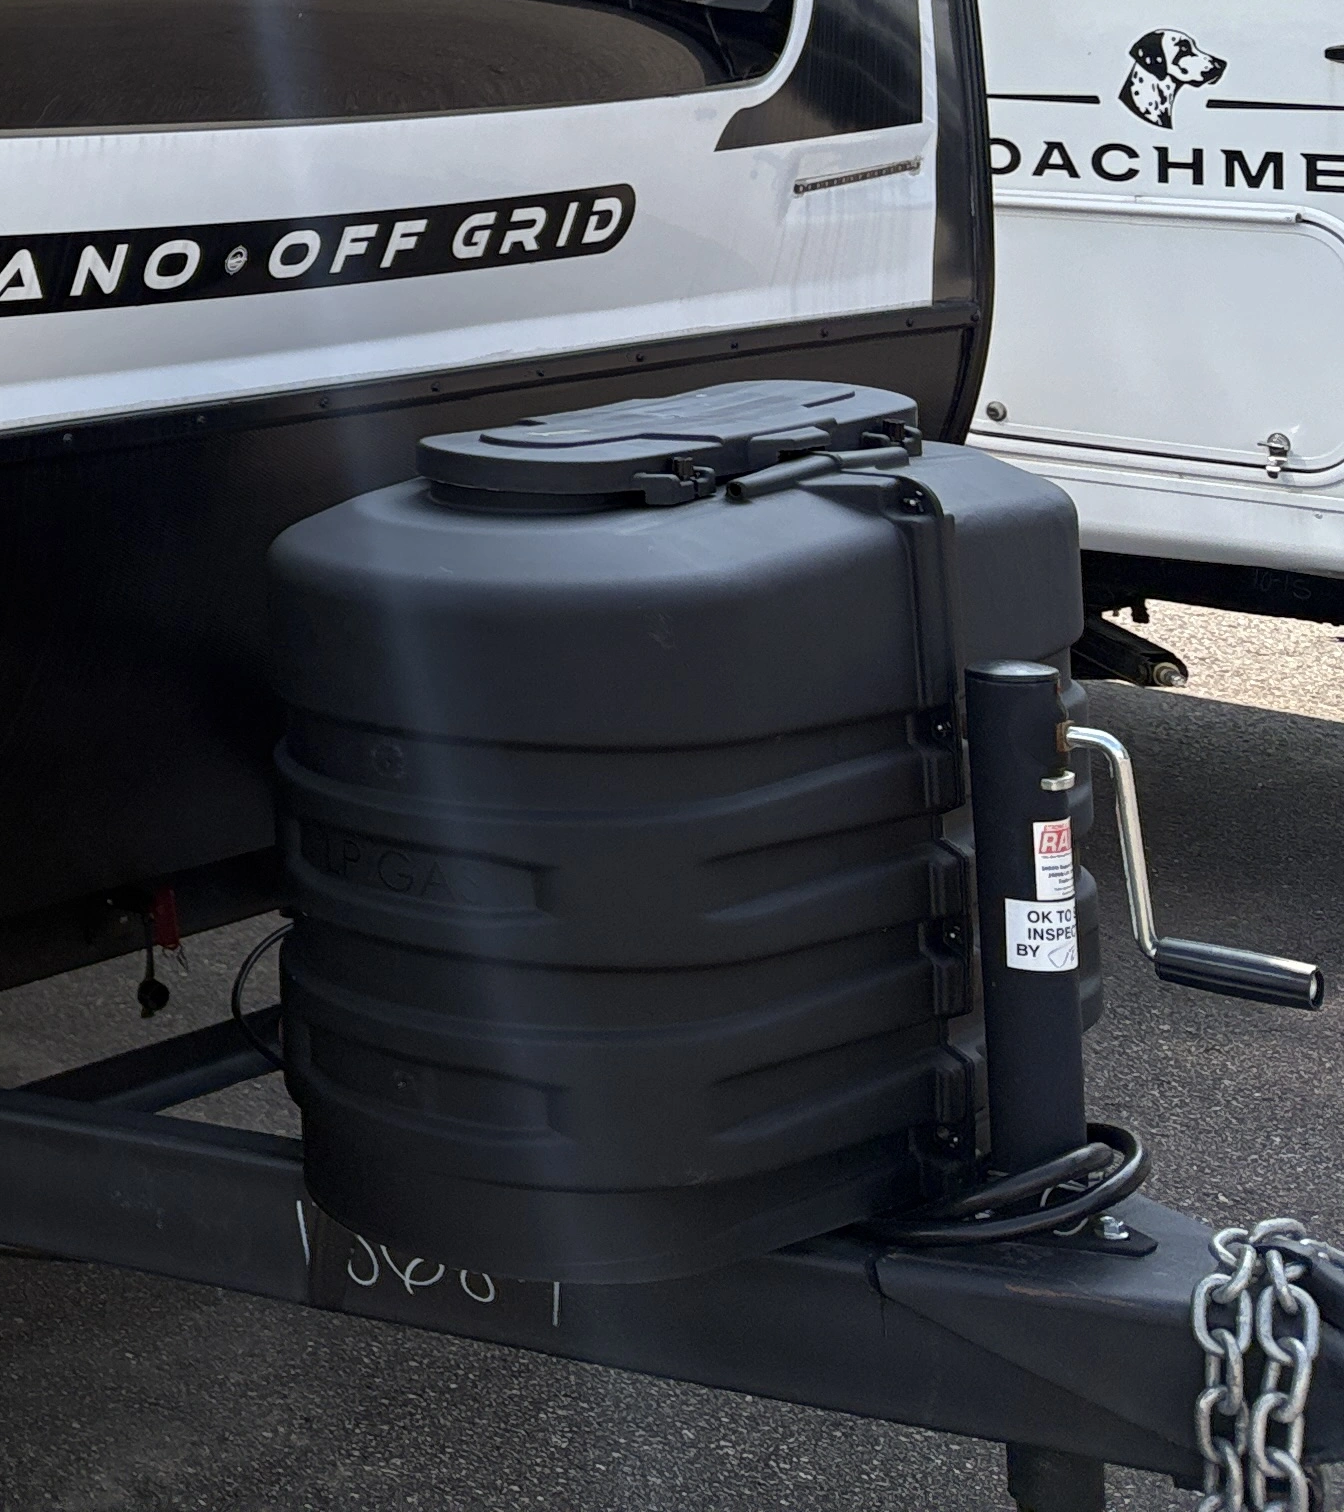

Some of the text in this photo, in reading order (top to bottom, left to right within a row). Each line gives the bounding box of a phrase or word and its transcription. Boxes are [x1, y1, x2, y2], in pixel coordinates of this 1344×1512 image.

[267, 219, 430, 279] OFF
[451, 195, 625, 258] GRID
[1040, 828, 1072, 854] RA
[1027, 910, 1072, 924] OK TO
[1016, 944, 1040, 958] BY
